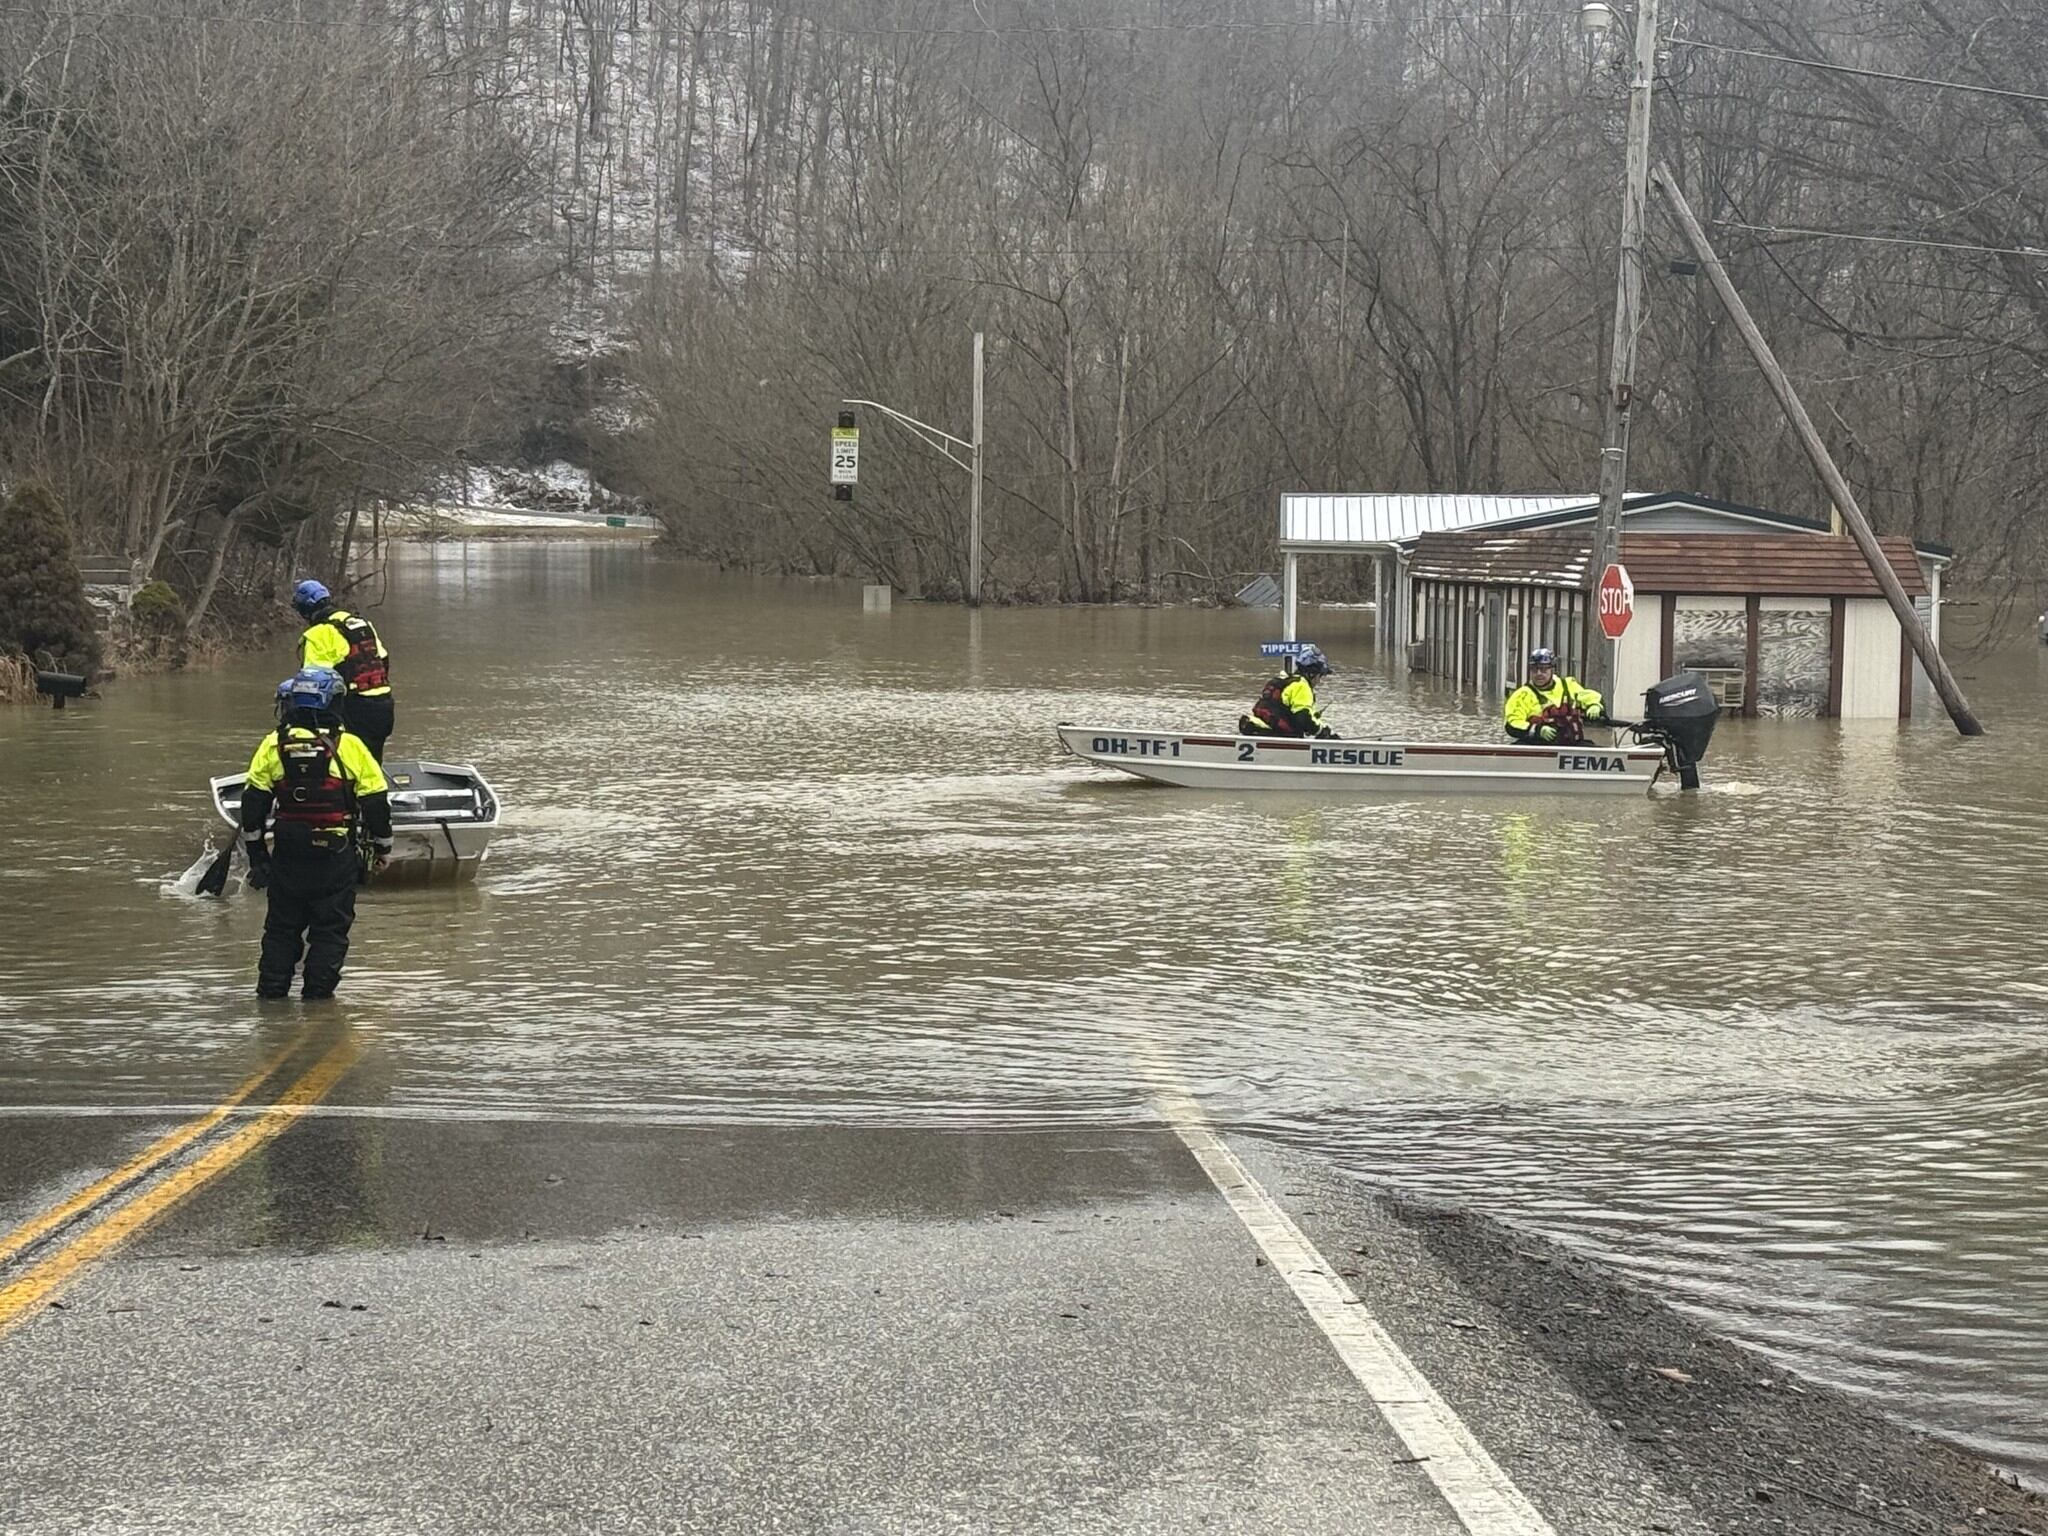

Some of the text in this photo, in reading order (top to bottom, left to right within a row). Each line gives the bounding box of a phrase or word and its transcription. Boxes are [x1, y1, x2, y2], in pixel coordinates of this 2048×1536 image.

[835, 455, 856, 468] 25
[1601, 587, 1630, 615] STOP
[1261, 643, 1300, 653] TIPPLE
[1658, 688, 1697, 704] MERCURY
[1238, 743, 1255, 762] 2
[1311, 748, 1403, 766] RESCUE
[1558, 754, 1626, 773] FEMA
